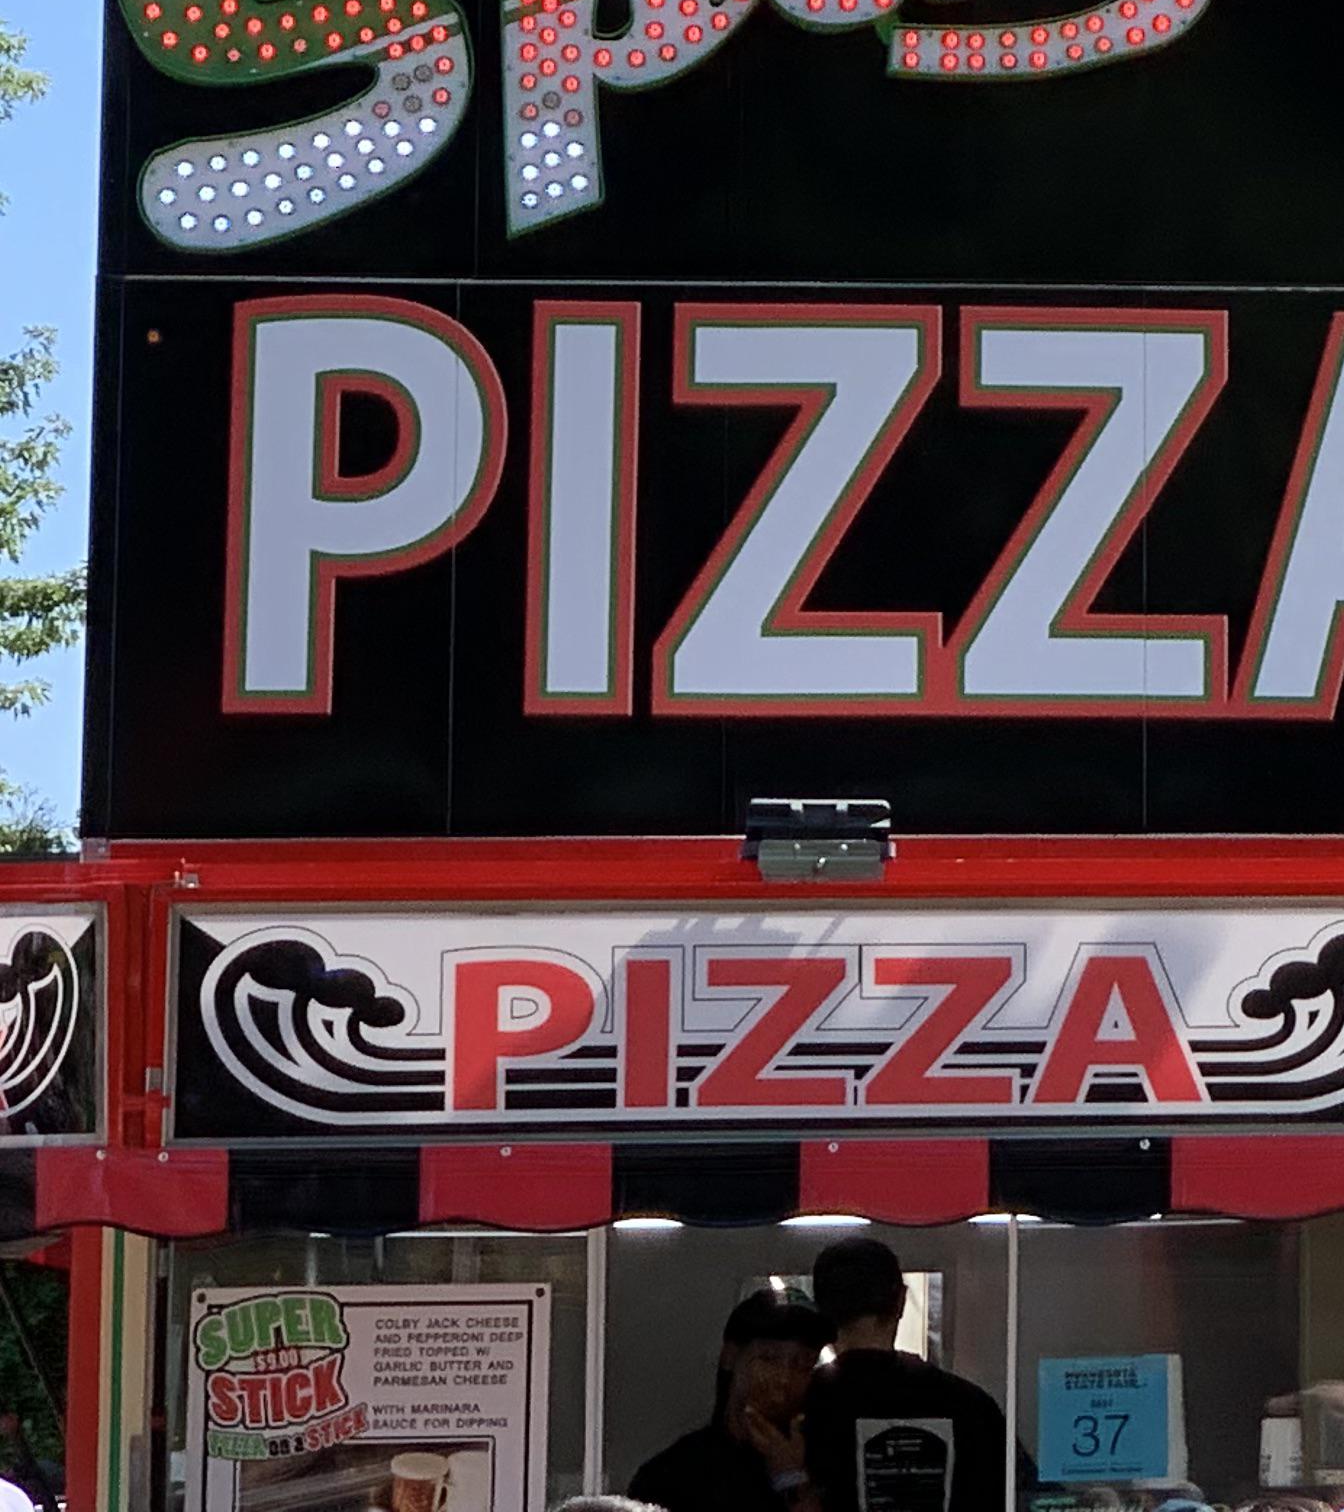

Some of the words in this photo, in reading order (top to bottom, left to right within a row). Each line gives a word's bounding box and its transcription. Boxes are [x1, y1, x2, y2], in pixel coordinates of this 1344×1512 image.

[449, 953, 1206, 1111] PIZZA
[375, 1318, 420, 1330] COLBY
[426, 1317, 460, 1329] JACK
[466, 1317, 519, 1328] CHEESE
[198, 1295, 347, 1369] SUPER
[374, 1333, 401, 1344] AND
[407, 1332, 484, 1344] PEPPERONI
[489, 1331, 523, 1342] DEEP
[374, 1347, 412, 1358] FRIED
[419, 1346, 469, 1357] TOPPED
[373, 1361, 422, 1372] GARLIC
[430, 1360, 481, 1371] BUTTER
[488, 1359, 513, 1370] AND
[373, 1375, 447, 1386] PARMESAN
[453, 1374, 508, 1385] CHEESE
[208, 1354, 346, 1426] STICK
[372, 1404, 405, 1415] WITH
[411, 1403, 480, 1414] MARINARA
[305, 1403, 368, 1451] STICK
[372, 1419, 416, 1430] SAUCE
[424, 1418, 449, 1429] FOR
[456, 1418, 508, 1428] DIPPING
[1072, 1413, 1130, 1457] 37
